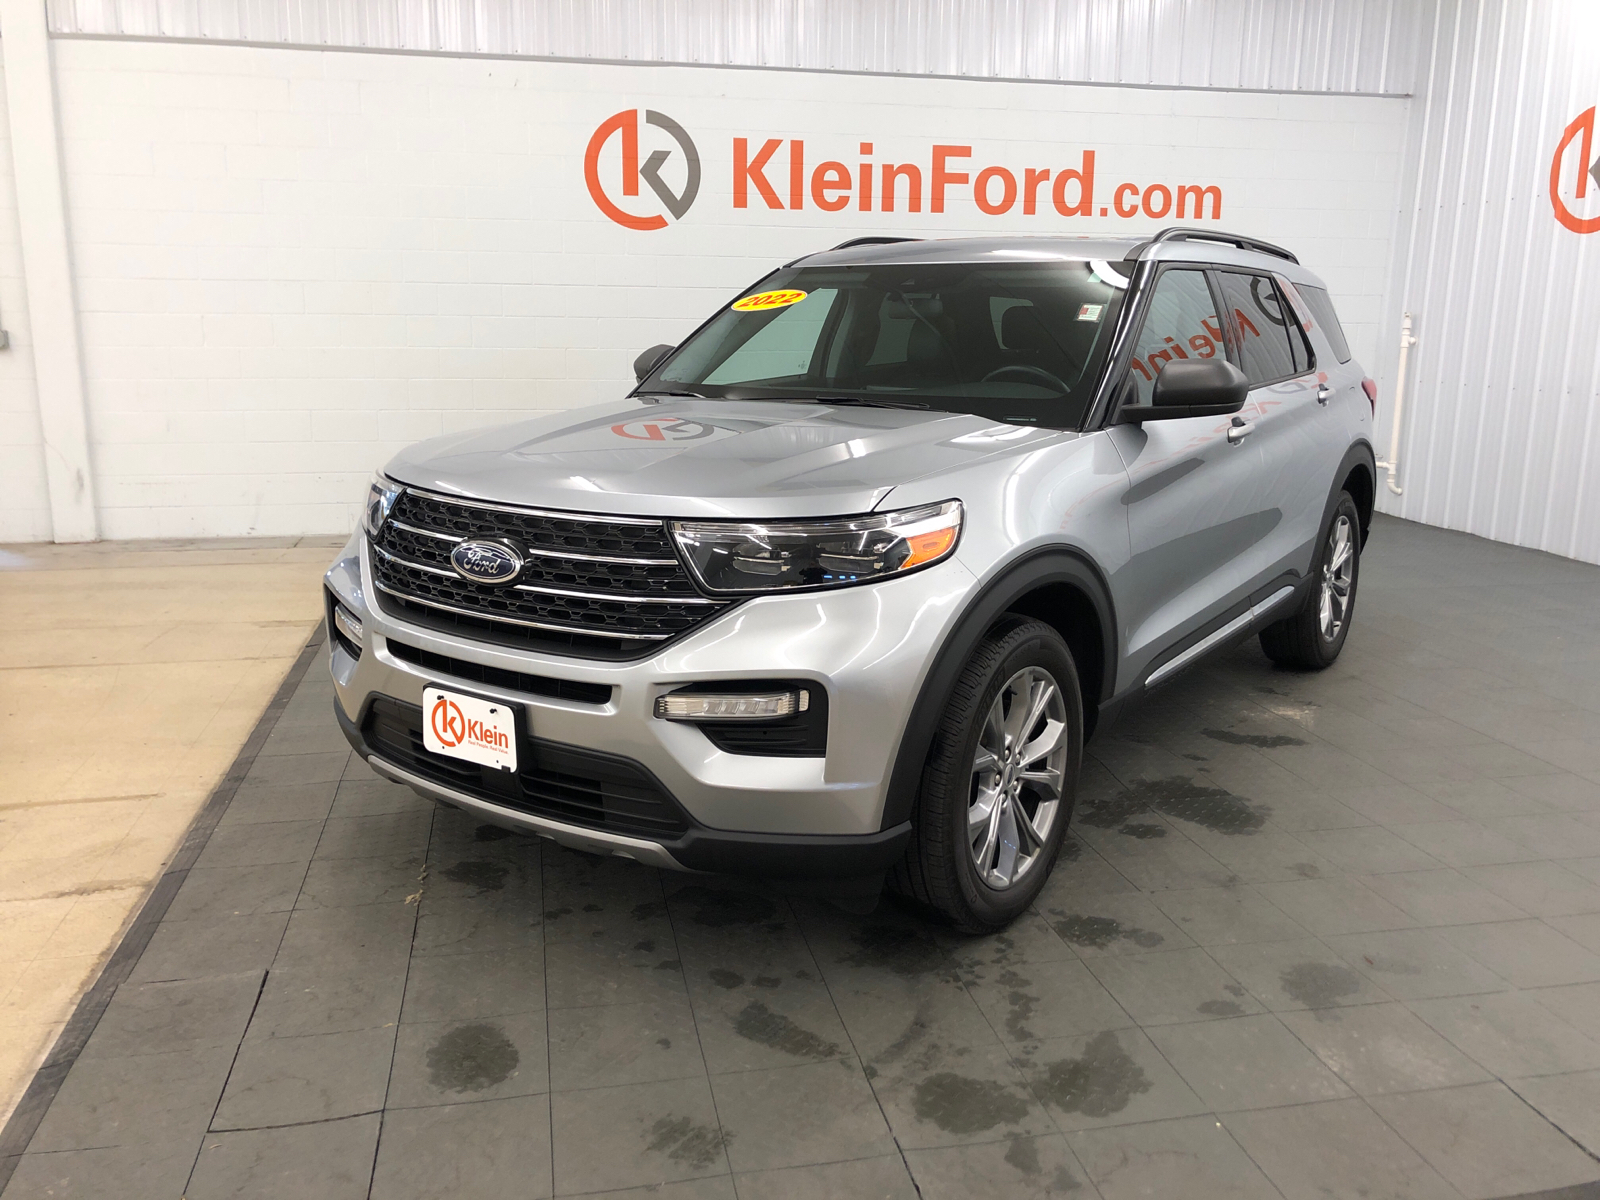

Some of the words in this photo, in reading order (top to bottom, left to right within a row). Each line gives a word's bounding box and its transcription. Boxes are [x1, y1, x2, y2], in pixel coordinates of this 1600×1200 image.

[733, 137, 1222, 221] KleinFord.com
[737, 292, 803, 308] 2022
[463, 547, 501, 574] Ford
[467, 718, 509, 749] Klein
